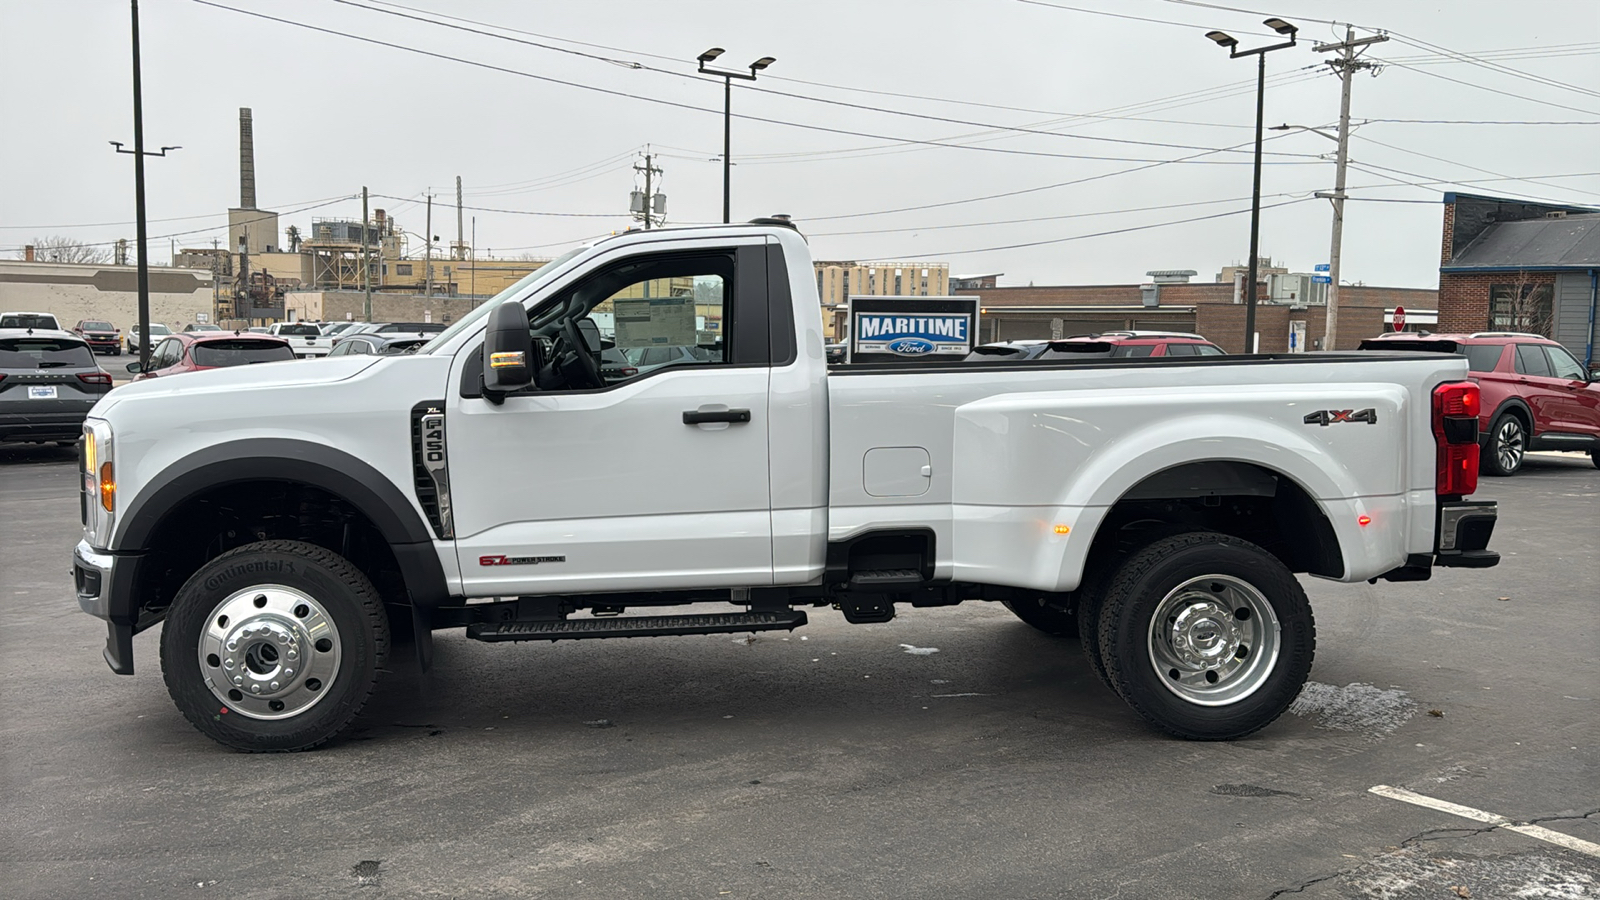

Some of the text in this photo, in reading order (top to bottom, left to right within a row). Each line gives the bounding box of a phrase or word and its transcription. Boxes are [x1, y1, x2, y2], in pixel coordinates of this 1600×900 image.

[861, 317, 965, 340] MARITIME
[896, 341, 925, 353] Ford
[204, 559, 284, 591] Continental
